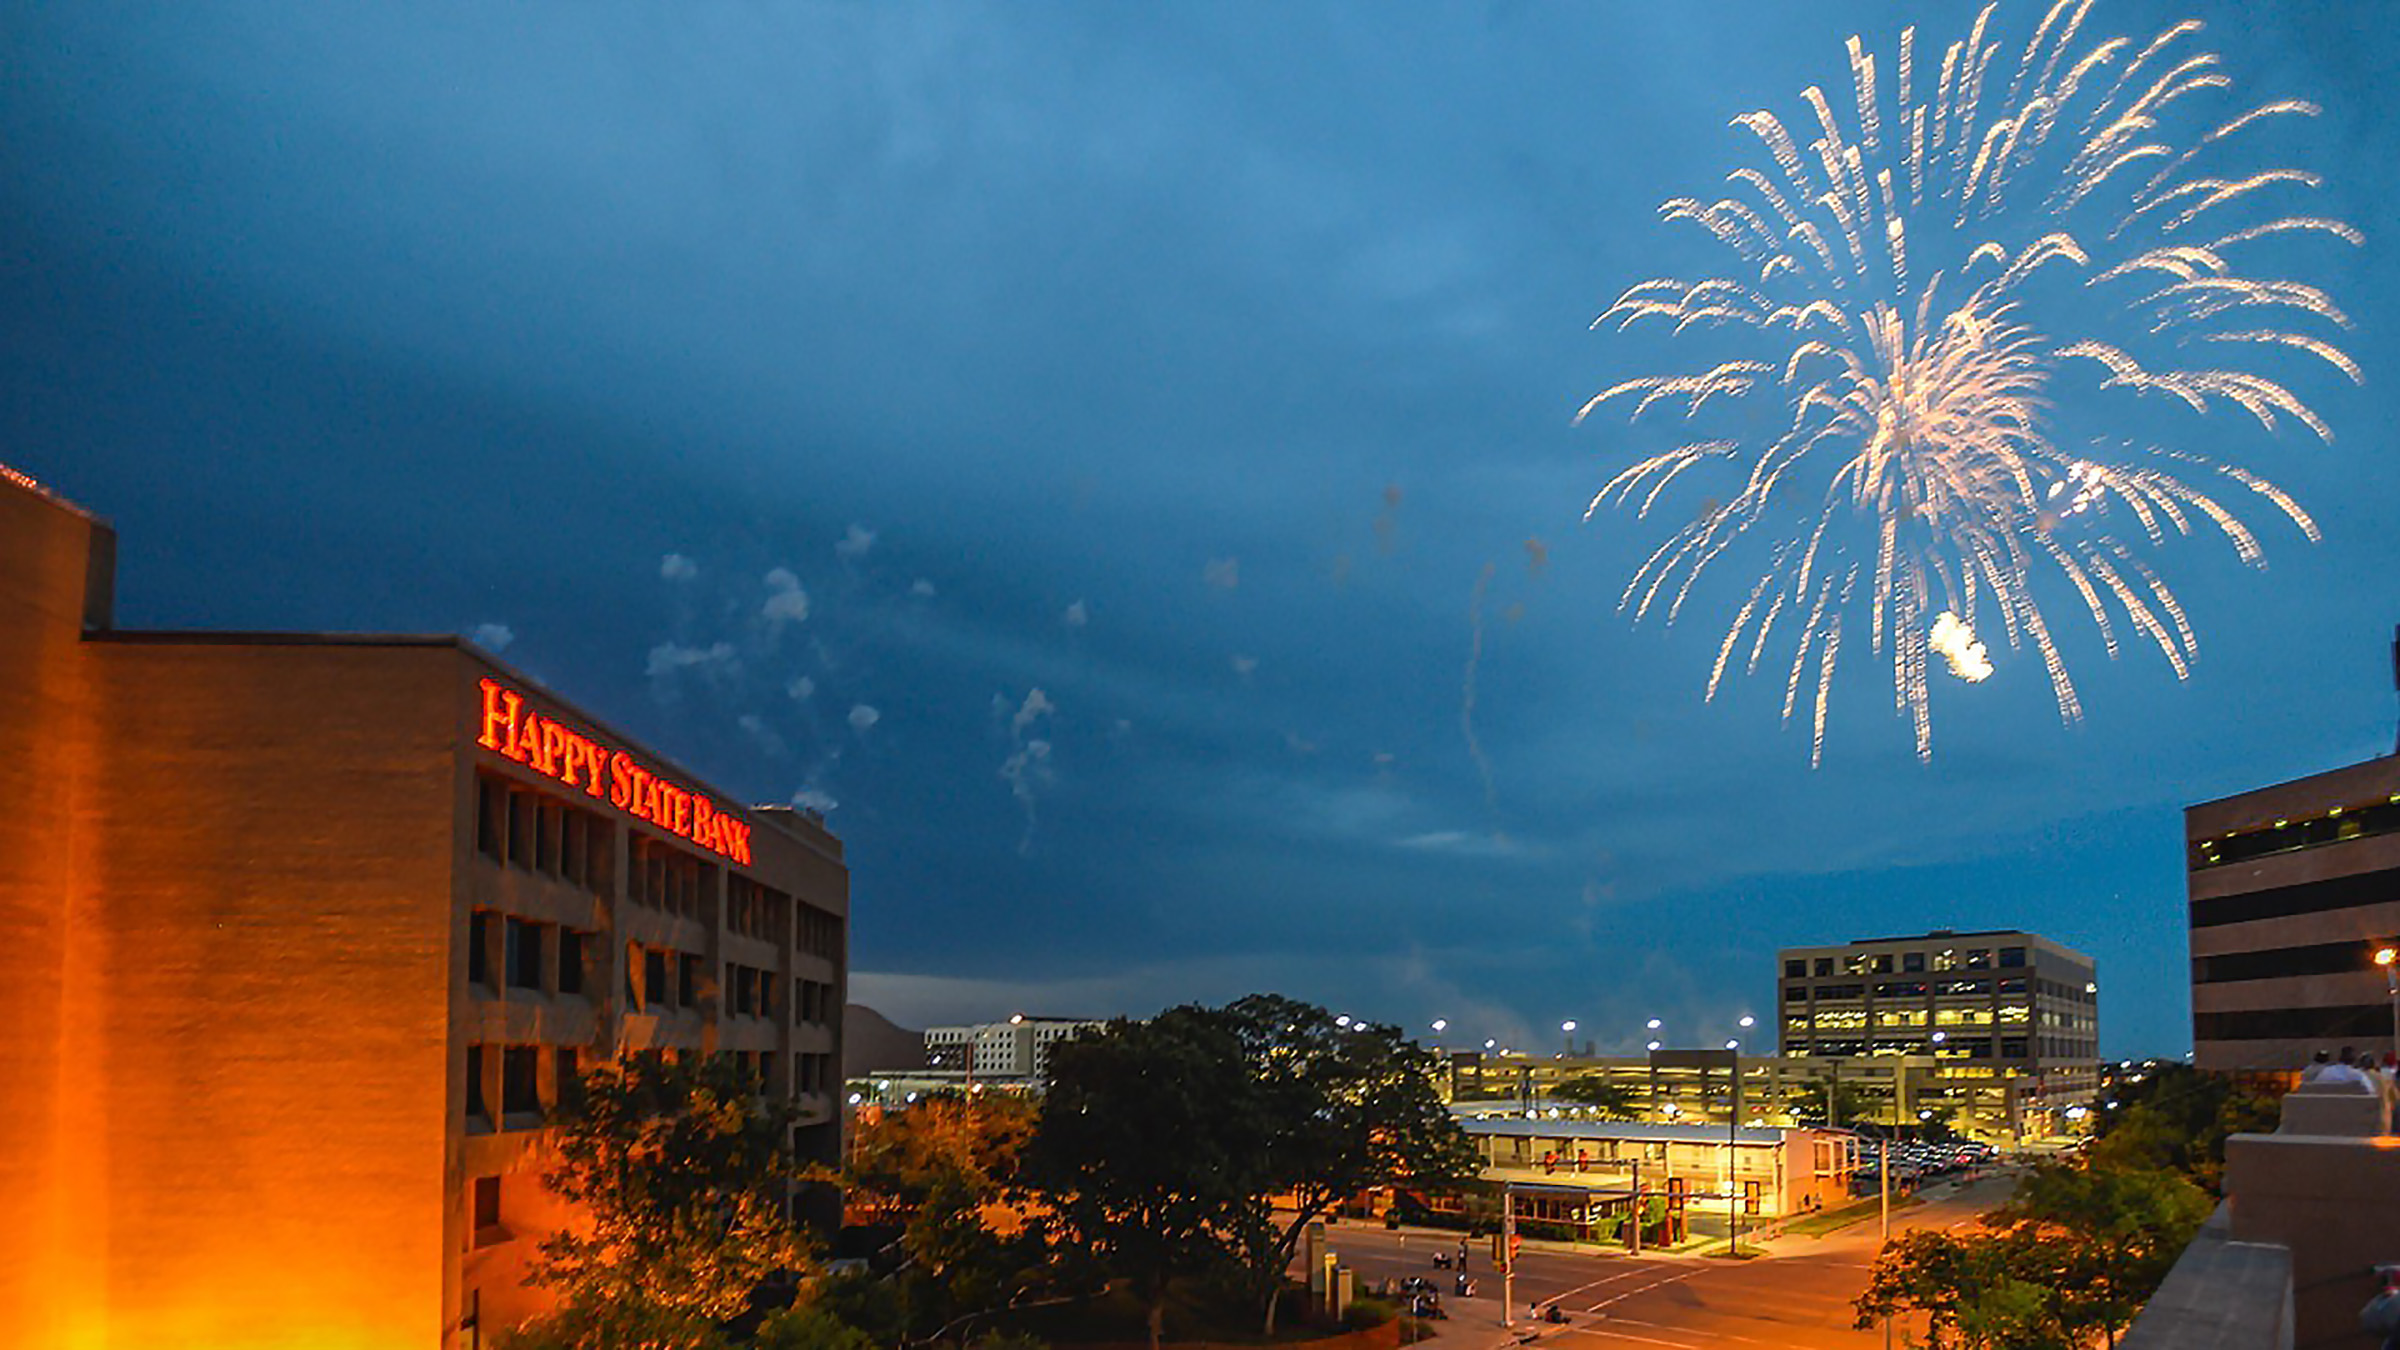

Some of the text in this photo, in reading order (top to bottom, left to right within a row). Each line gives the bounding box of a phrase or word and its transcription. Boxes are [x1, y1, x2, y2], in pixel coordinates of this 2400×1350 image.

[476, 676, 750, 865] HAPPY STATE BANK
